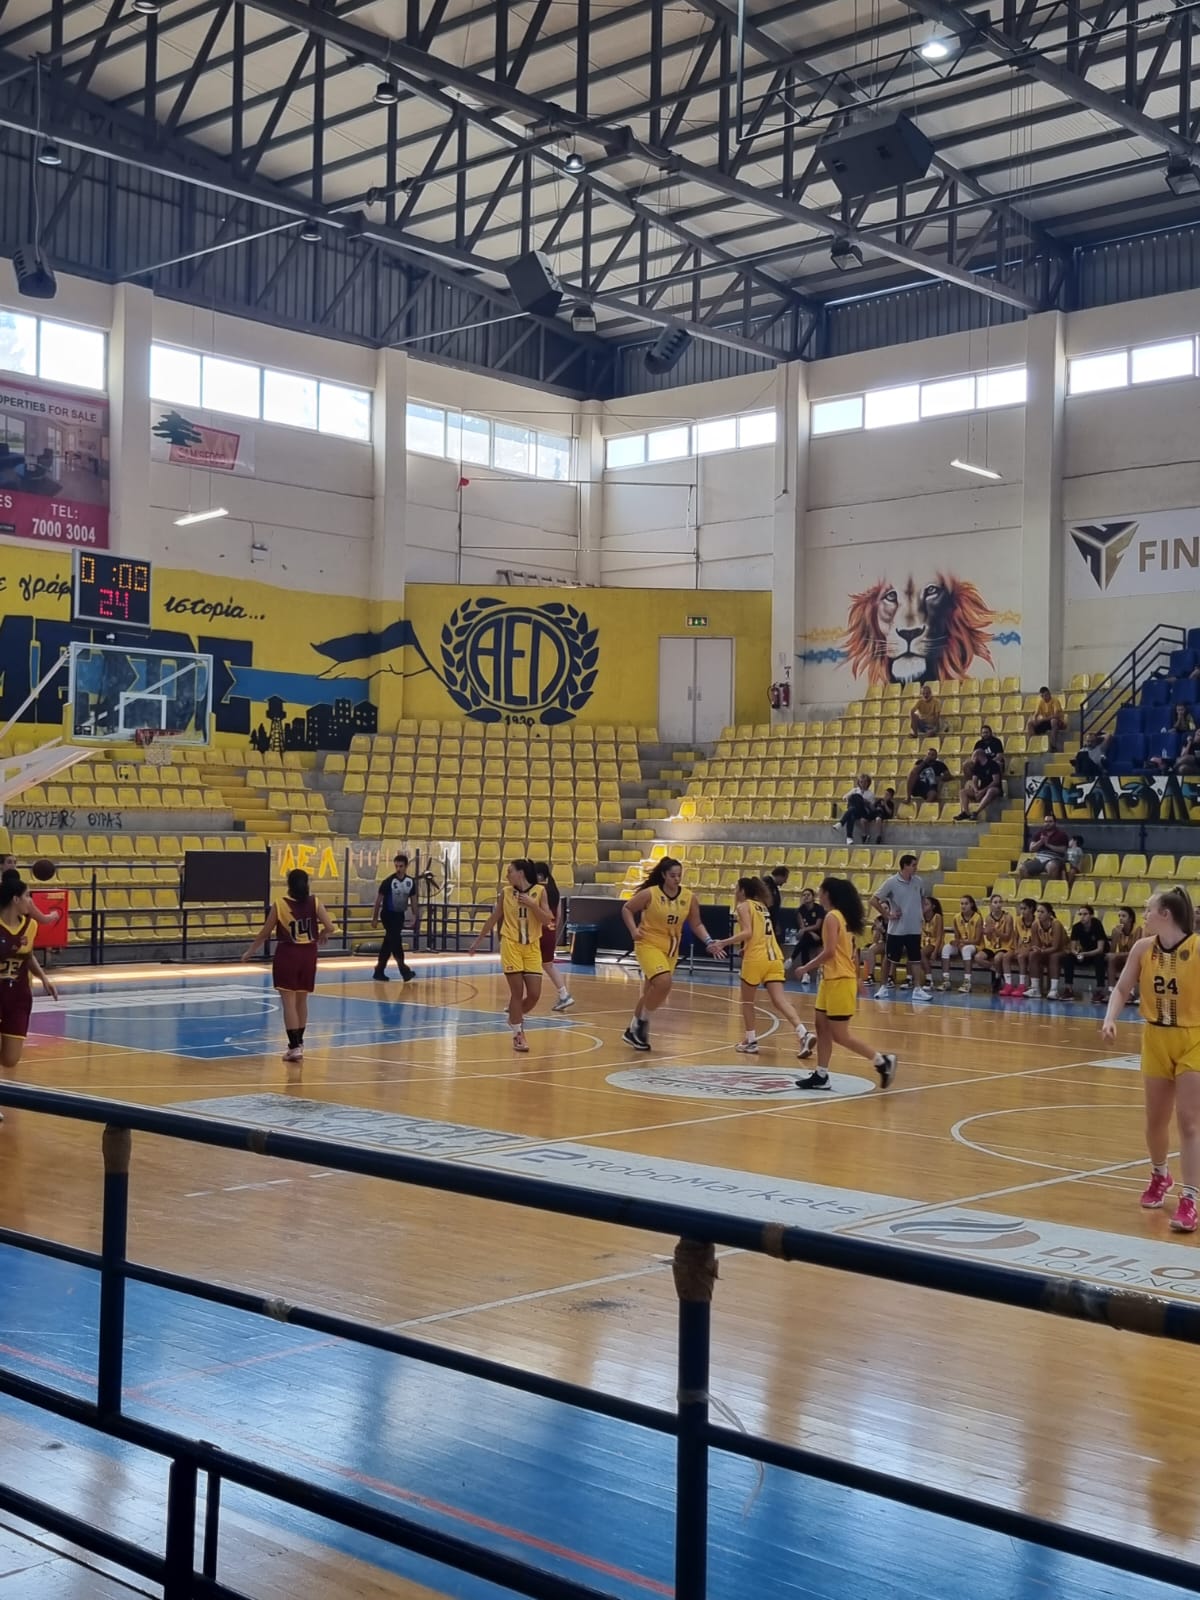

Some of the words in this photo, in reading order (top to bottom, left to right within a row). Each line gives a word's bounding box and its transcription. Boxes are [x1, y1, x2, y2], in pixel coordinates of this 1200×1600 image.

[48, 405, 70, 416] FOR
[71, 409, 97, 422] SALE
[50, 503, 79, 519] TEL:
[32, 518, 62, 537] 7000
[66, 523, 96, 543] 3004
[1139, 536, 1200, 573] FIN
[81, 556, 95, 583] 0
[19, 573, 71, 601] γράφ
[99, 588, 129, 619] 24
[504, 714, 535, 728] 1930
[3, 809, 76, 829] UPPORTERS
[519, 907, 527, 918] 11
[667, 914, 679, 925] 21
[288, 917, 315, 941] 14
[1153, 975, 1179, 995] 24
[572, 1159, 863, 1215] RoboMarkets
[1014, 1255, 1200, 1295] HOLDING
